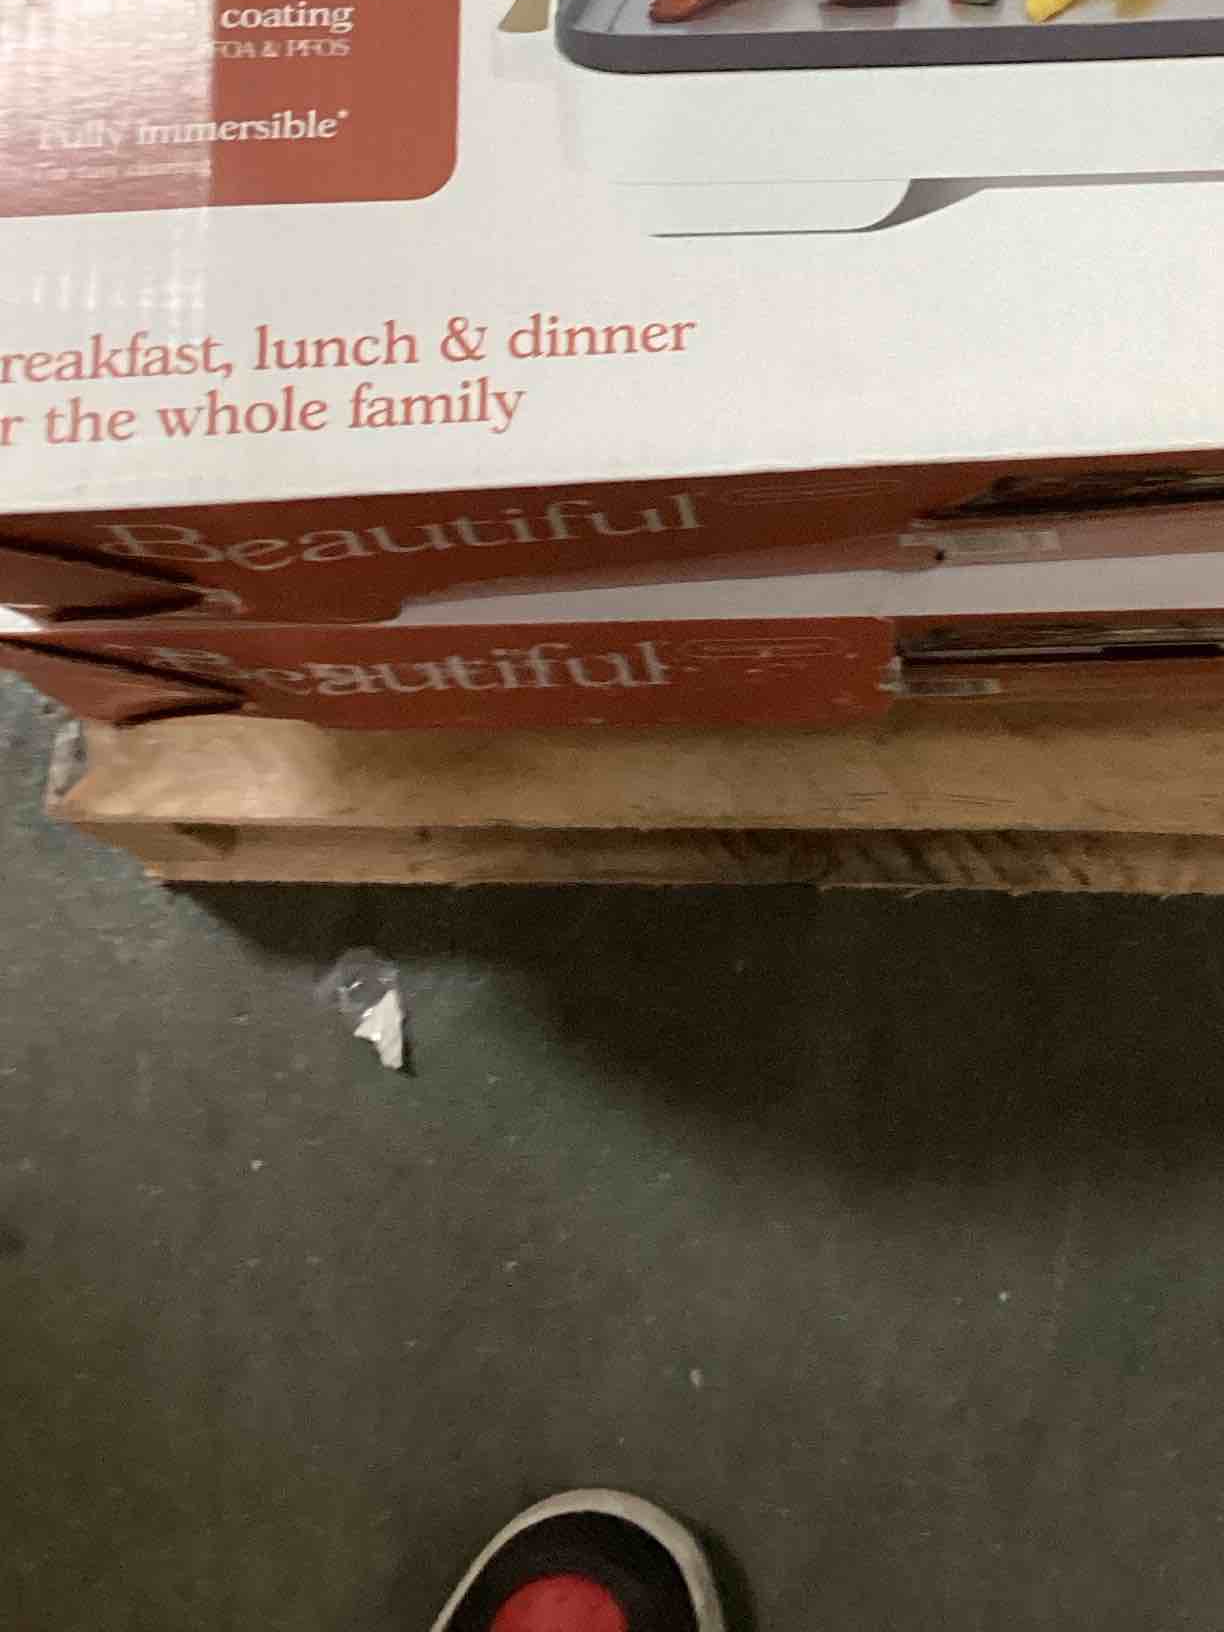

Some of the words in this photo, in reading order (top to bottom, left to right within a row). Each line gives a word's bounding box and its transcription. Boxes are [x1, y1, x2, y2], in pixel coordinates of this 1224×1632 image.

[220, 2, 355, 33] coating
[254, 319, 419, 372] lunch
[439, 316, 487, 362] &
[508, 313, 699, 360] dinner
[44, 398, 137, 445] the
[155, 385, 328, 438] whole
[348, 377, 527, 435] family
[98, 492, 706, 570] Beautiful
